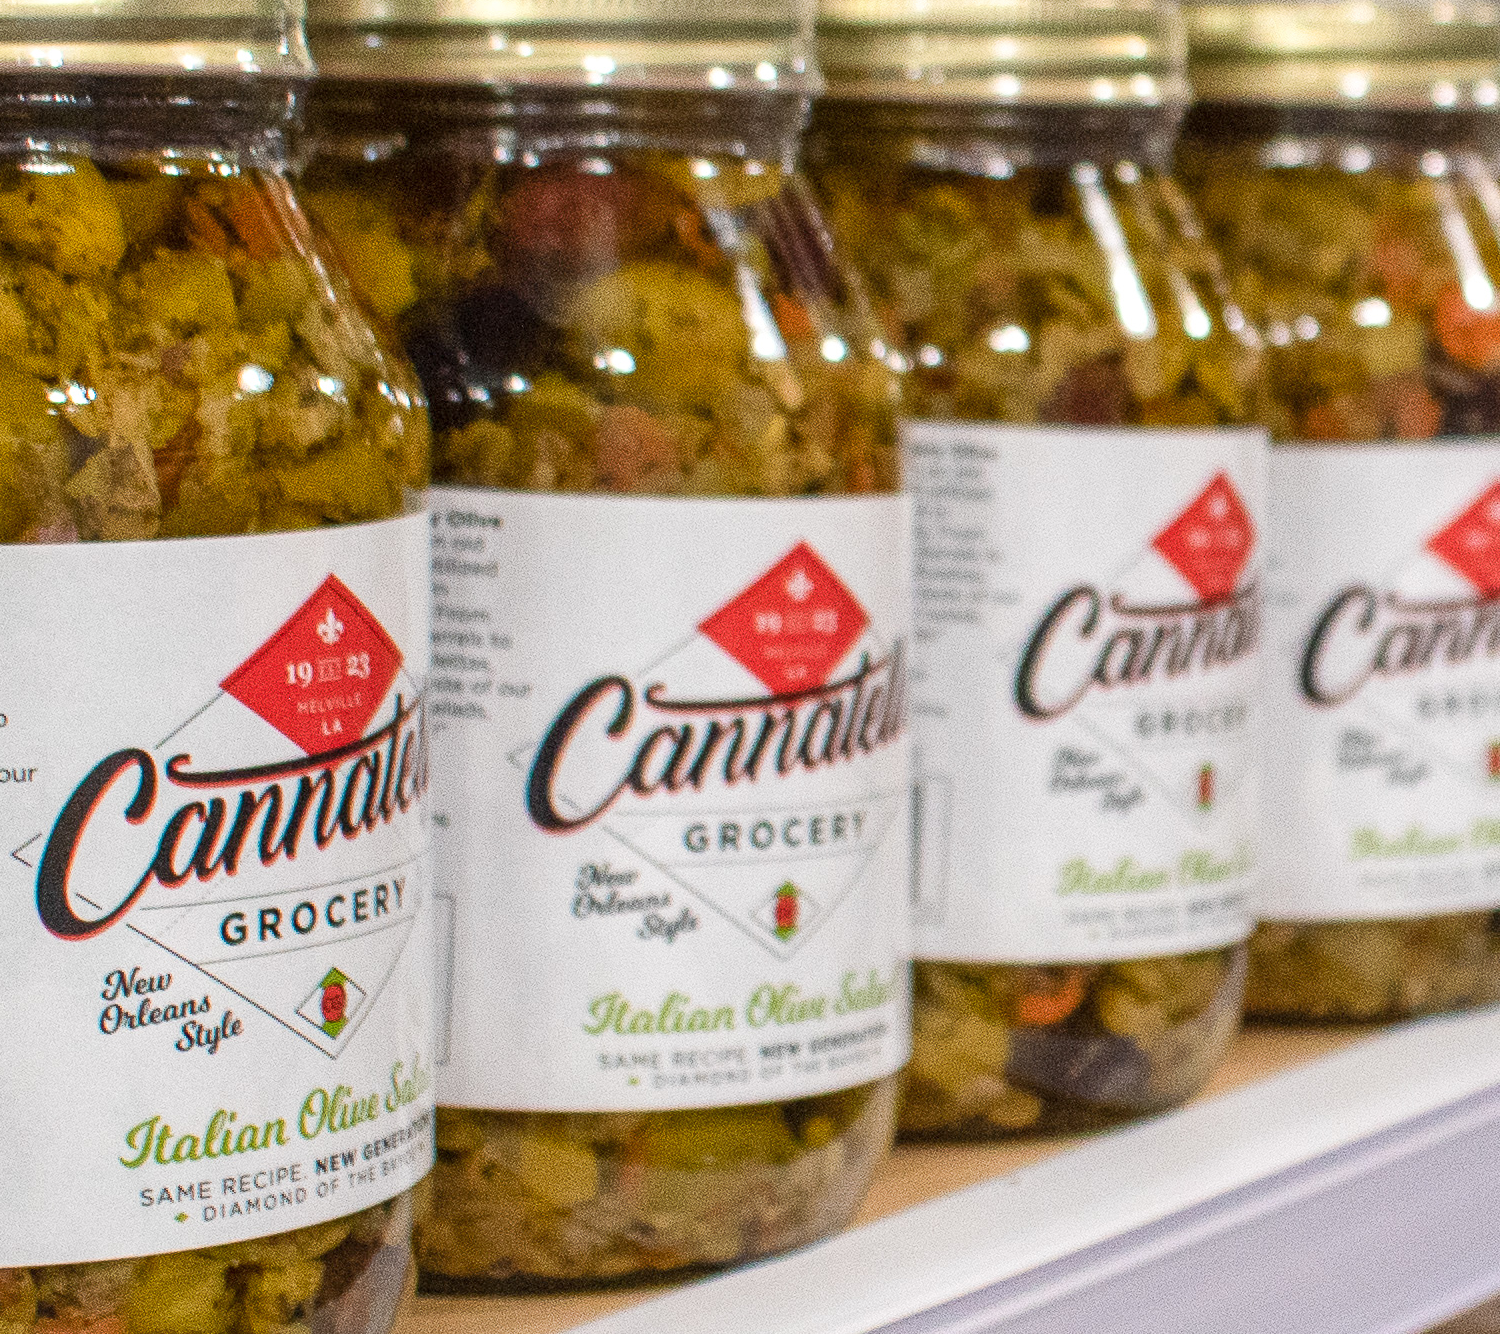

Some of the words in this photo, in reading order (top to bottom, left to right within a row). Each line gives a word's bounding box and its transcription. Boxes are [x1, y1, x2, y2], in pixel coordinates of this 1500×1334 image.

[286, 662, 314, 687] 19
[346, 651, 371, 679] 23
[320, 718, 344, 737] LA
[219, 876, 407, 947] GROCERY
[101, 966, 174, 1002] New
[99, 995, 213, 1037] Orleans
[174, 1009, 245, 1055] Style
[583, 991, 736, 1036] Italian
[118, 1107, 291, 1169] Italian
[297, 1084, 381, 1141] Olive
[140, 1181, 212, 1208] SAME
[314, 1147, 357, 1176] NEW
[202, 1188, 308, 1224] DIAMOND
[316, 1176, 341, 1200] OF
